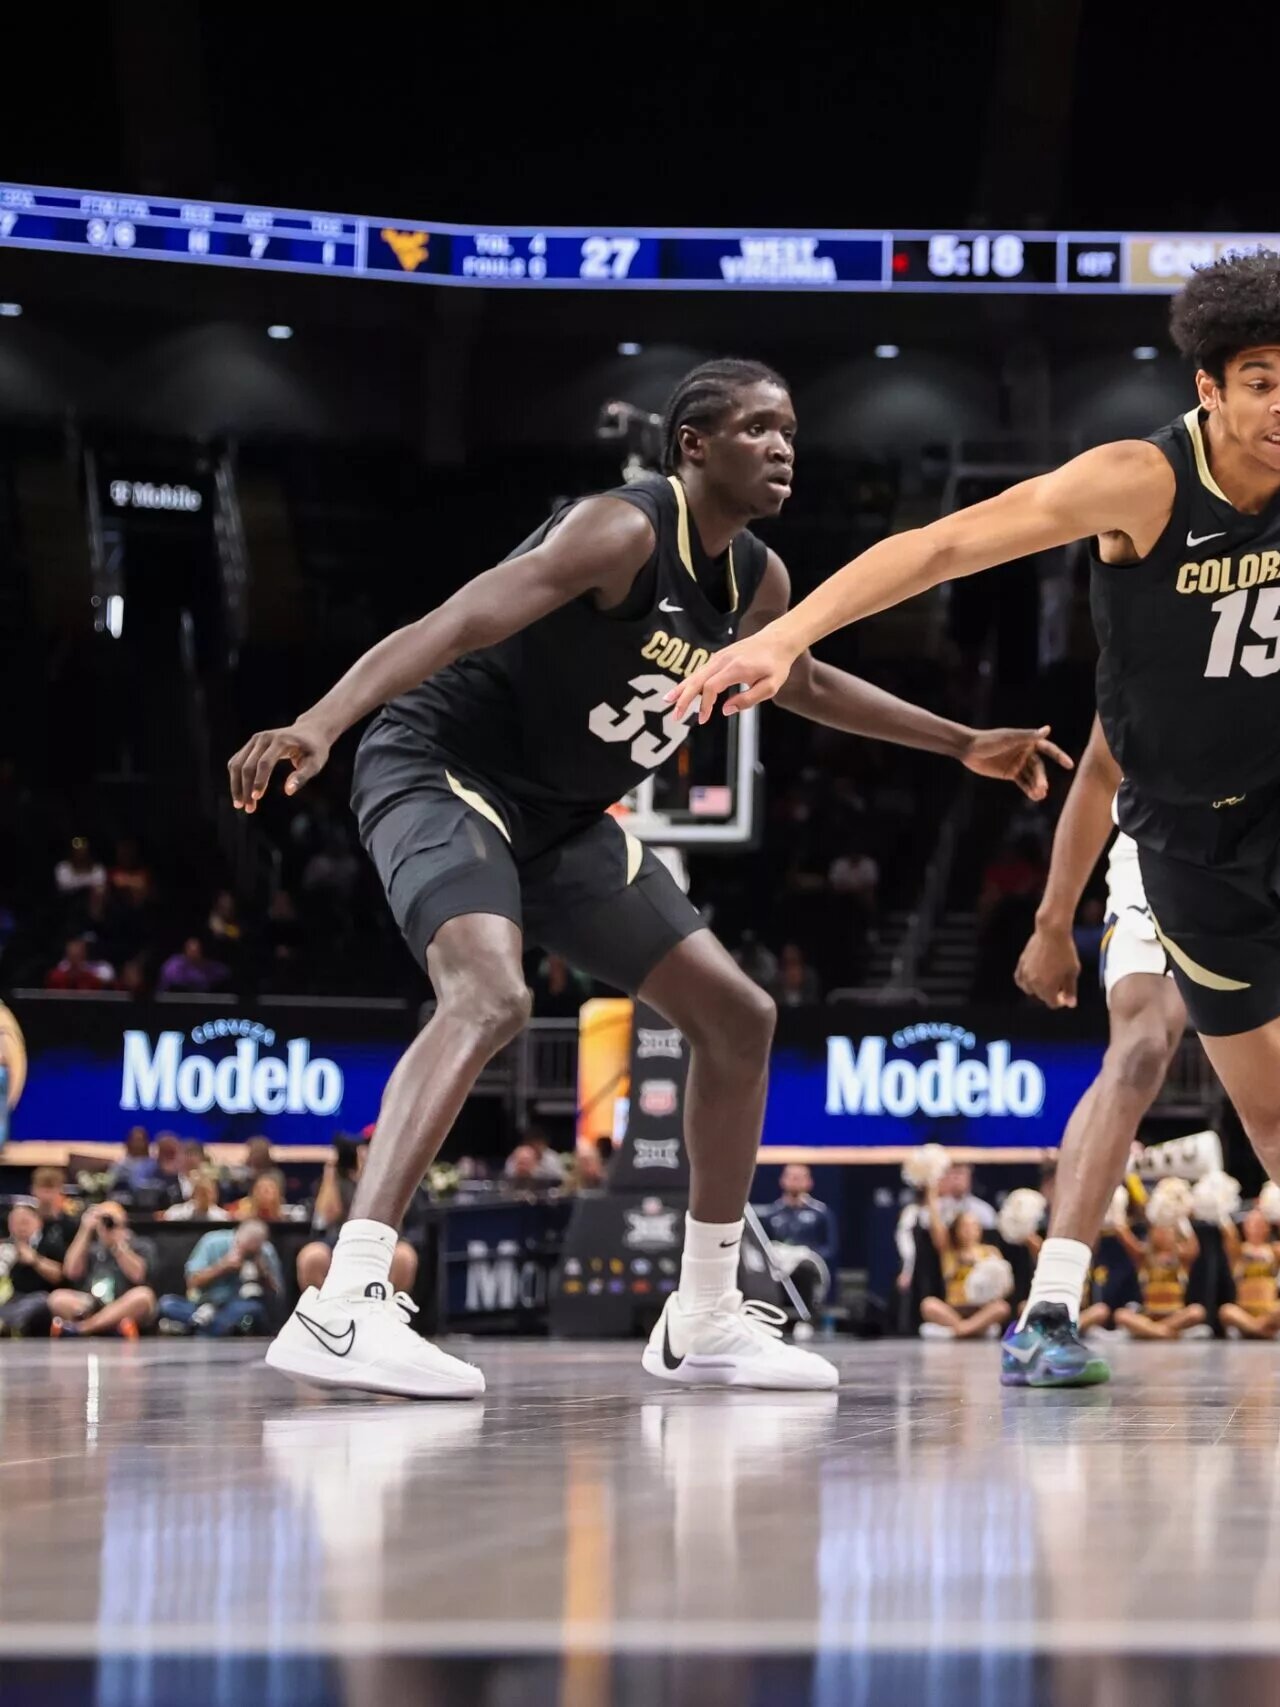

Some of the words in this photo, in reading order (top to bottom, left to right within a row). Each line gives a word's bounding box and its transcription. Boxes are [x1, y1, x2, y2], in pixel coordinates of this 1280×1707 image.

[580, 236, 640, 279] 27
[640, 630, 714, 678] COLO
[119, 1030, 344, 1116] Modelo
[824, 1035, 1045, 1117] Modelo
